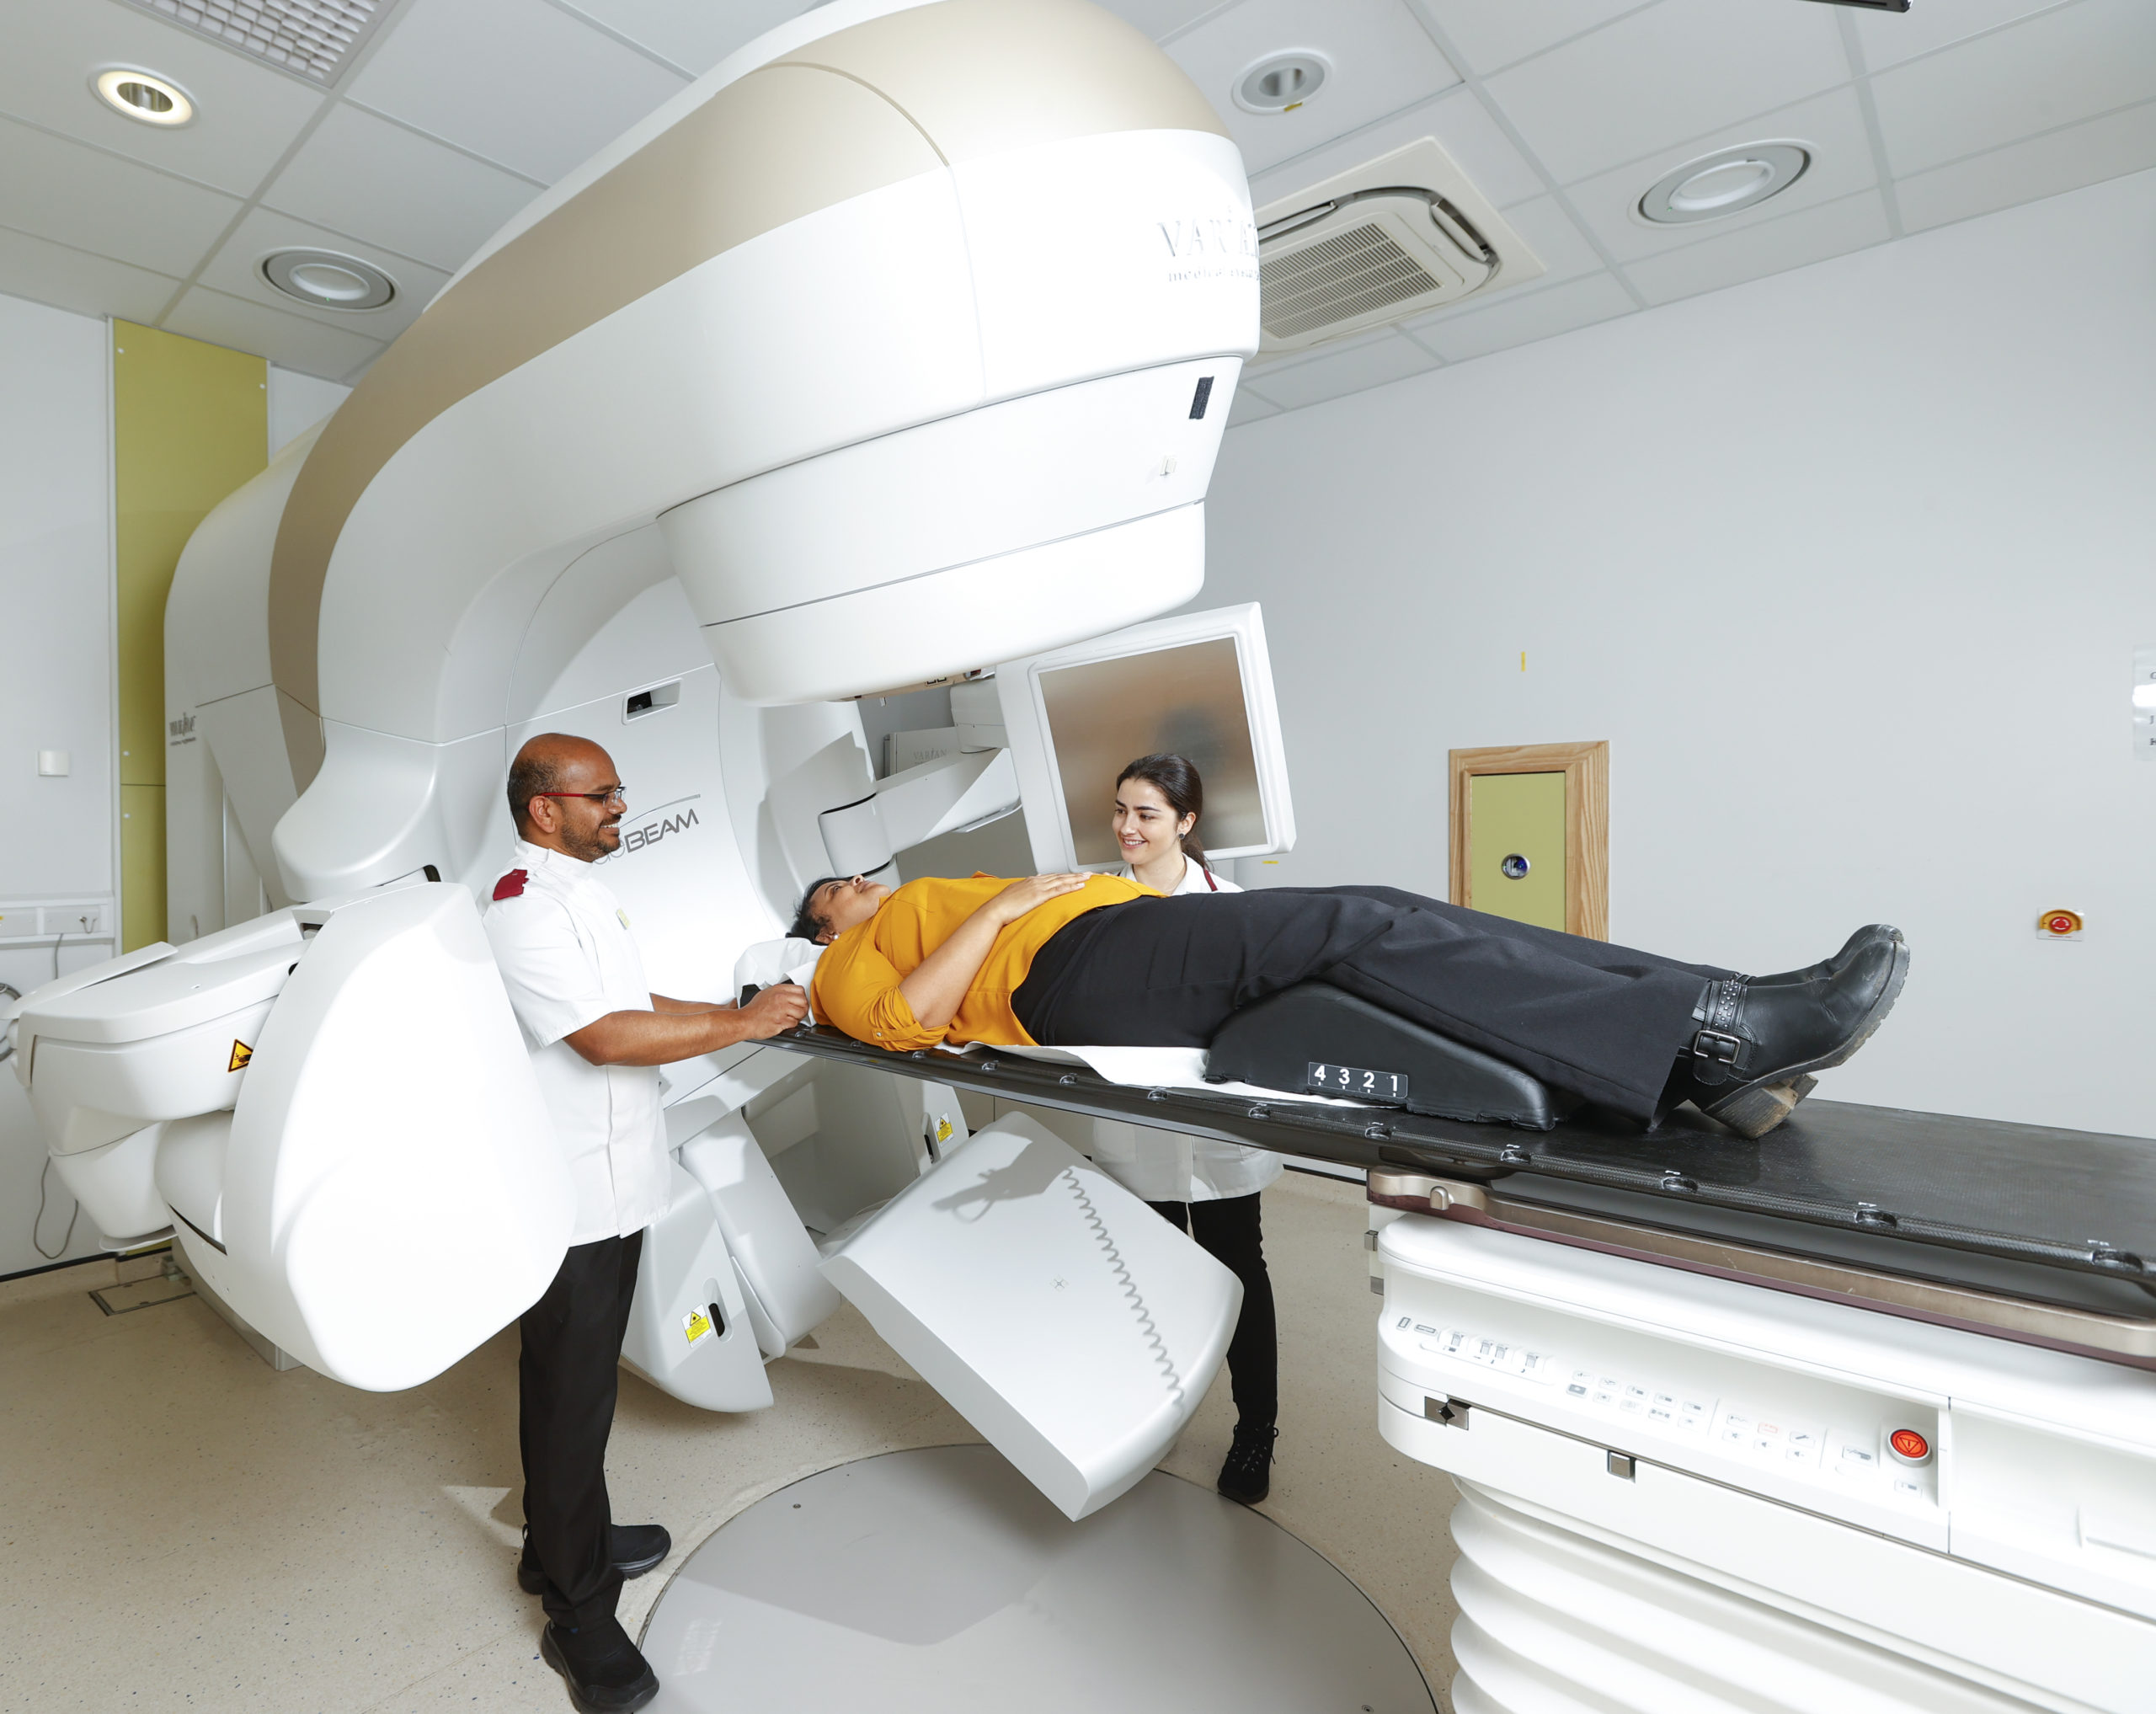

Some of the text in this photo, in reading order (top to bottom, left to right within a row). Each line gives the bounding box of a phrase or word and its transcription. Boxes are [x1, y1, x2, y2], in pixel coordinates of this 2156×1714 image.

[1314, 1065, 1398, 1092] 4 3 2 1
